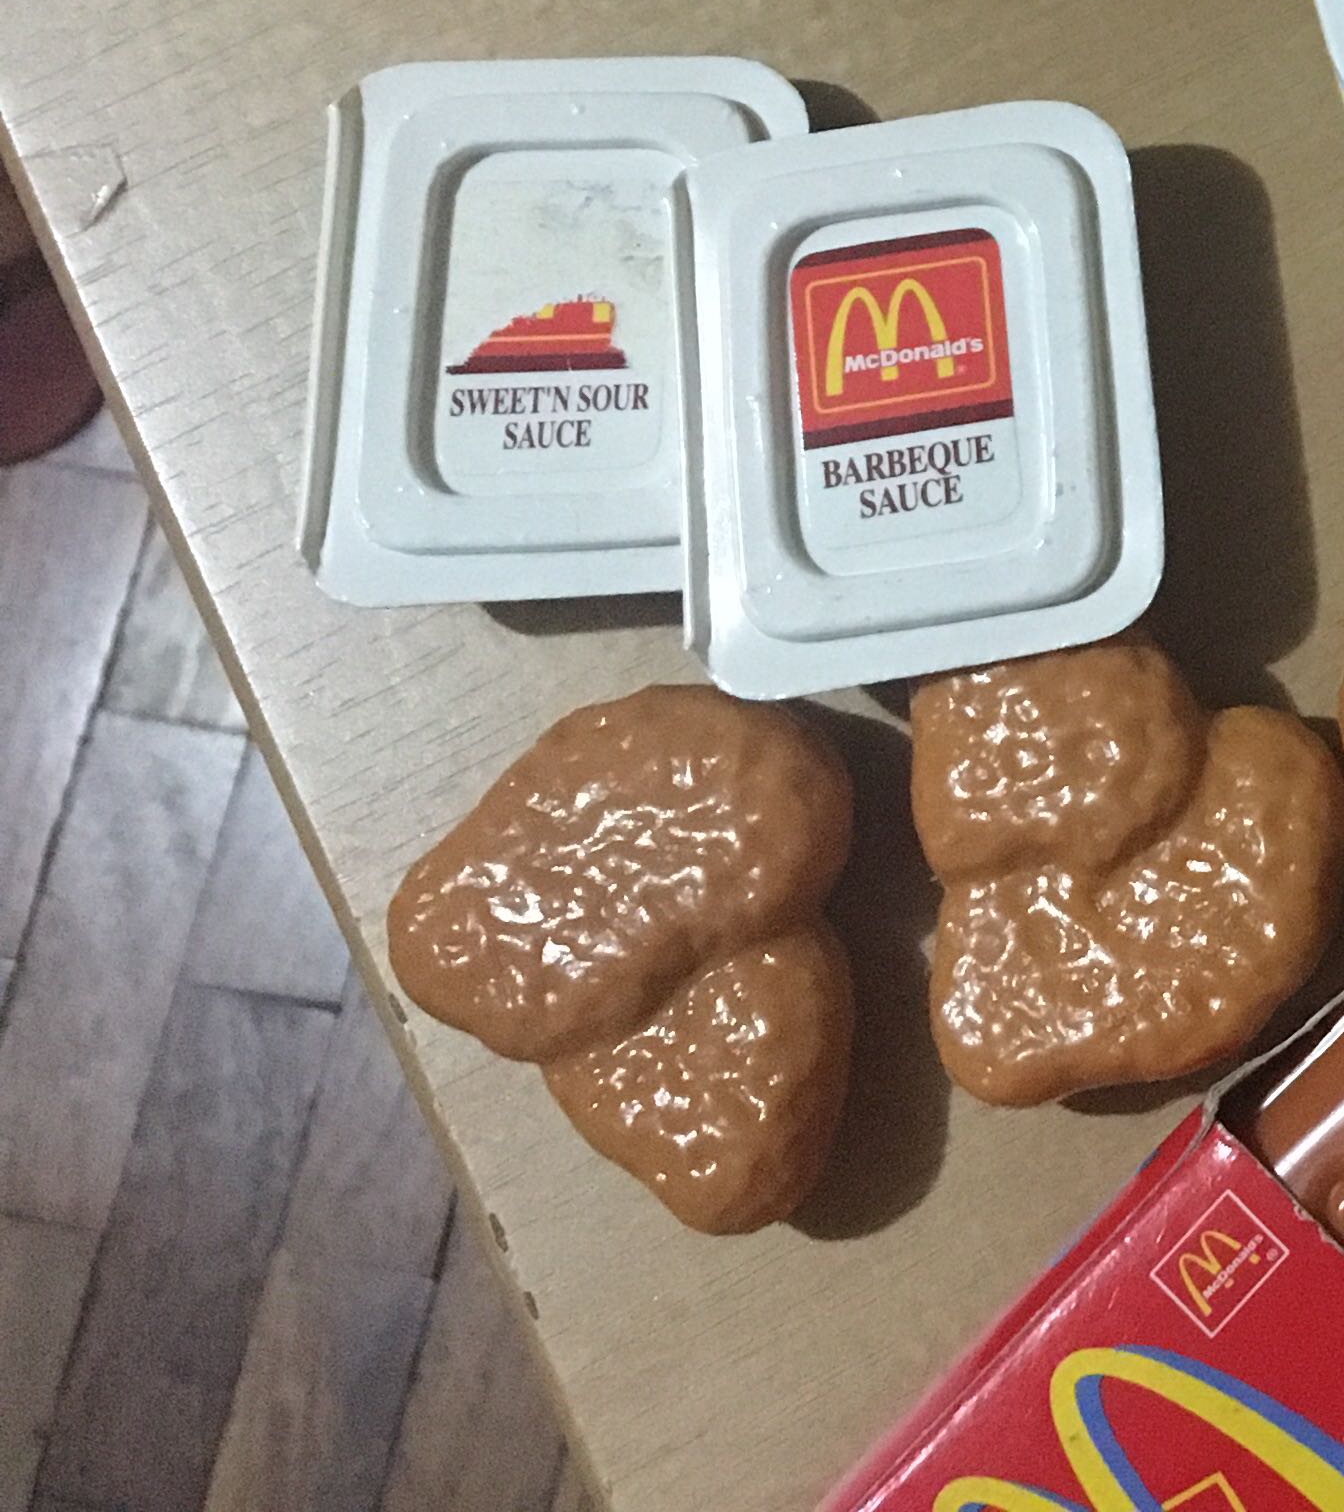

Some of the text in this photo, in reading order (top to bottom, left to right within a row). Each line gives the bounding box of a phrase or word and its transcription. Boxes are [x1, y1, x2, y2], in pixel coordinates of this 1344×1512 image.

[844, 336, 984, 373] McDonald's
[449, 383, 650, 417] SWEET'N SOUR
[503, 419, 592, 450] SAUCE
[821, 433, 996, 489] BARBEQUE
[859, 474, 965, 520] SAUCE
